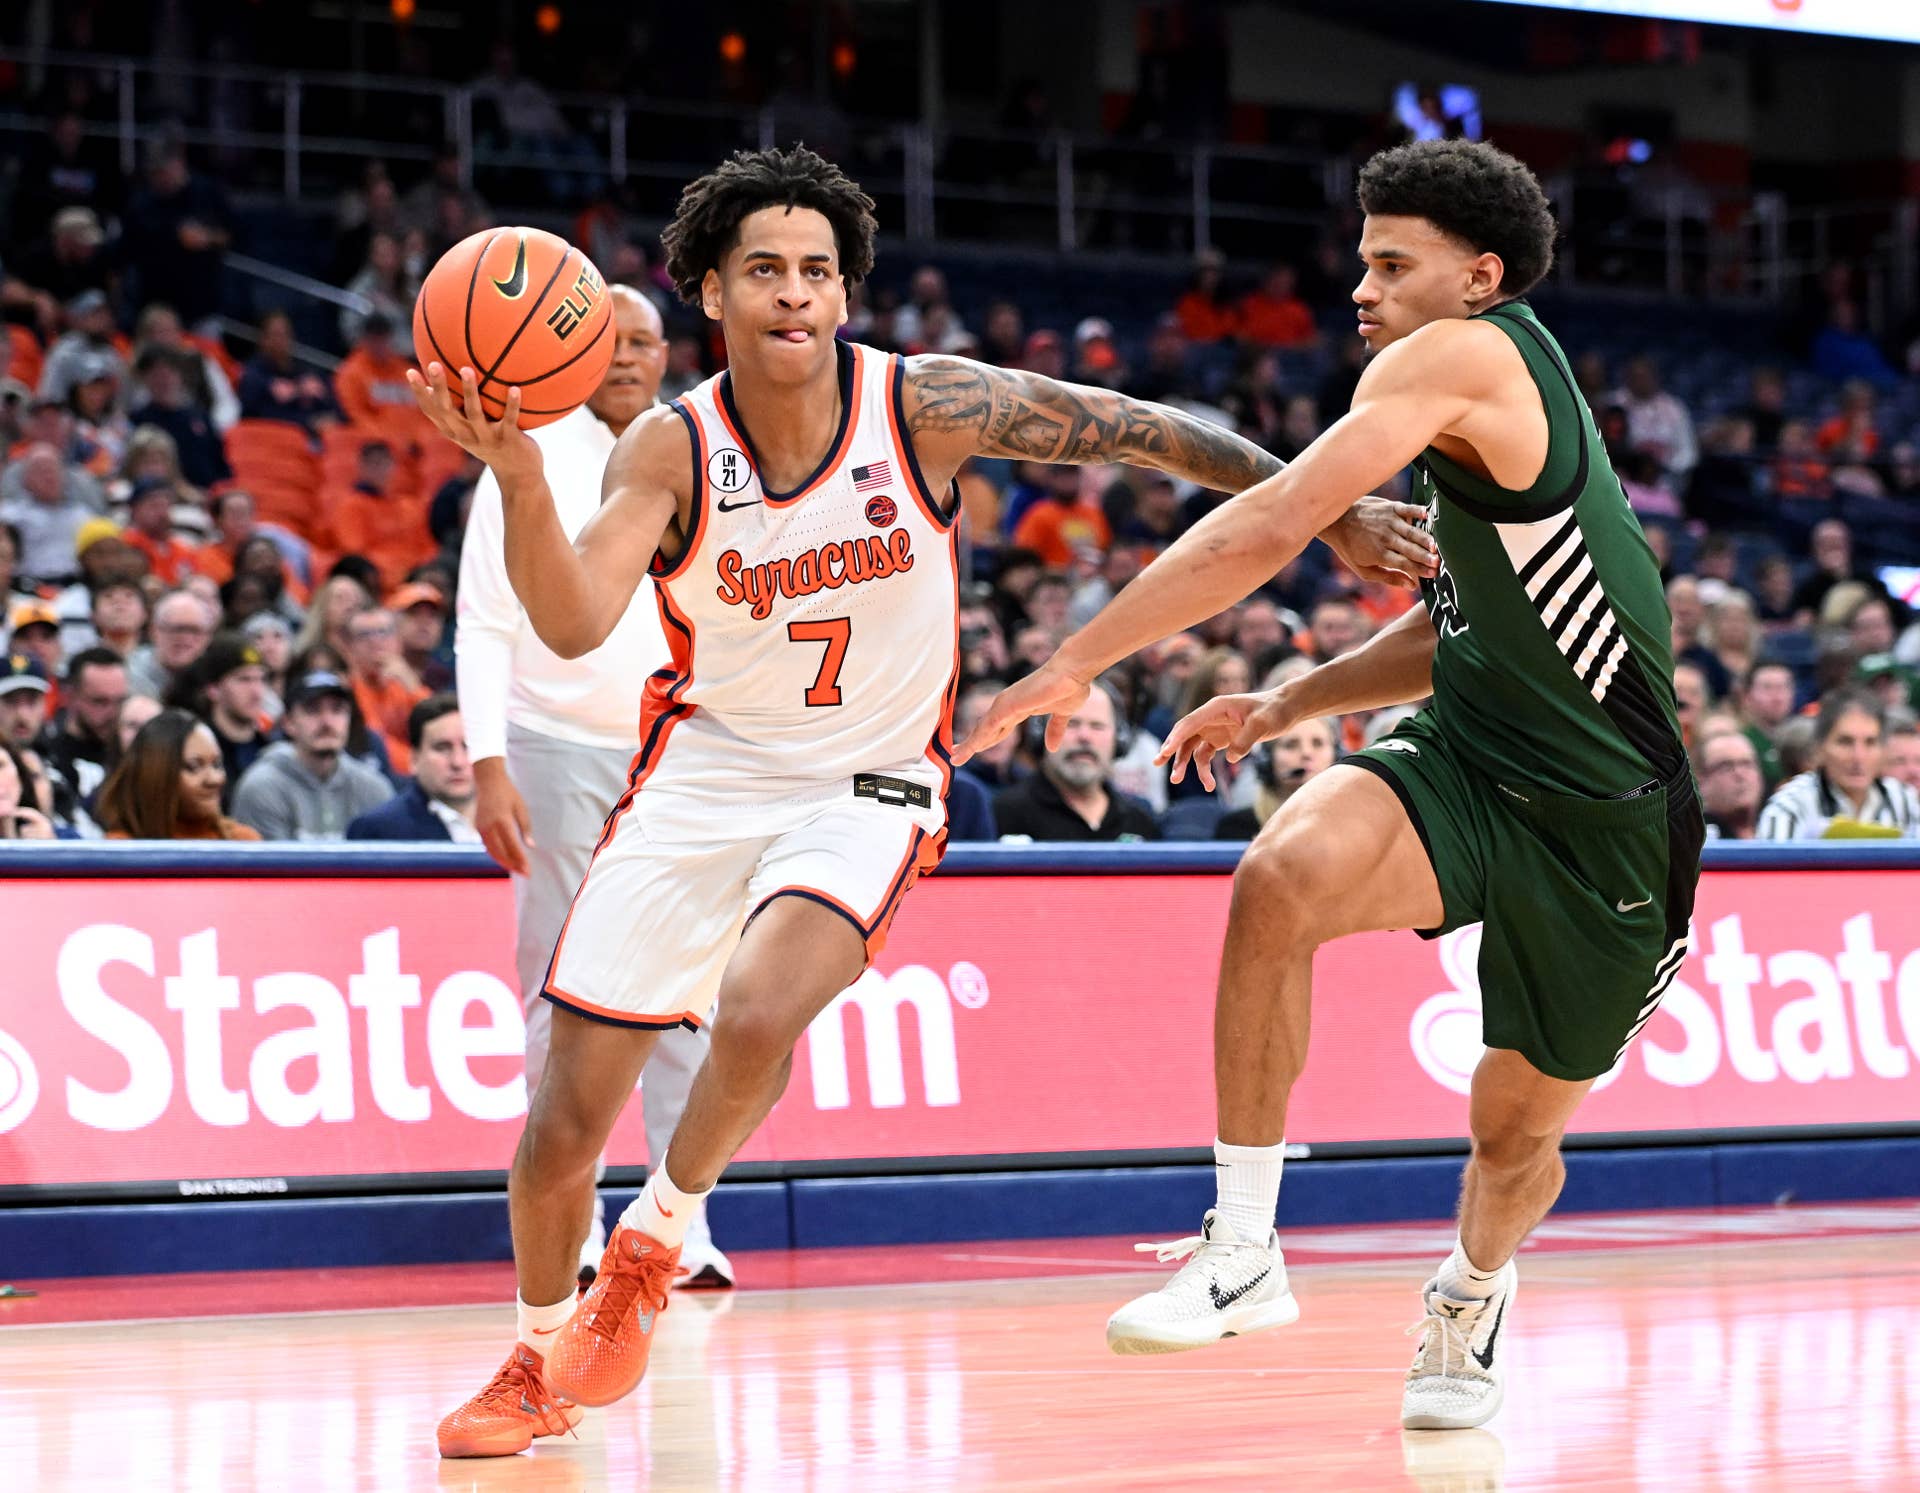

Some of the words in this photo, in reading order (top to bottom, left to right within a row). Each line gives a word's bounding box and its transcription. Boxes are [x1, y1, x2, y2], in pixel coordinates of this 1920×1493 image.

[545, 265, 601, 341] ELITE
[722, 454, 736, 467] LM
[722, 468, 736, 487] 21
[716, 528, 914, 620] Syracuse
[788, 616, 852, 707] 7
[909, 789, 921, 799] 46
[57, 924, 528, 1131] State
